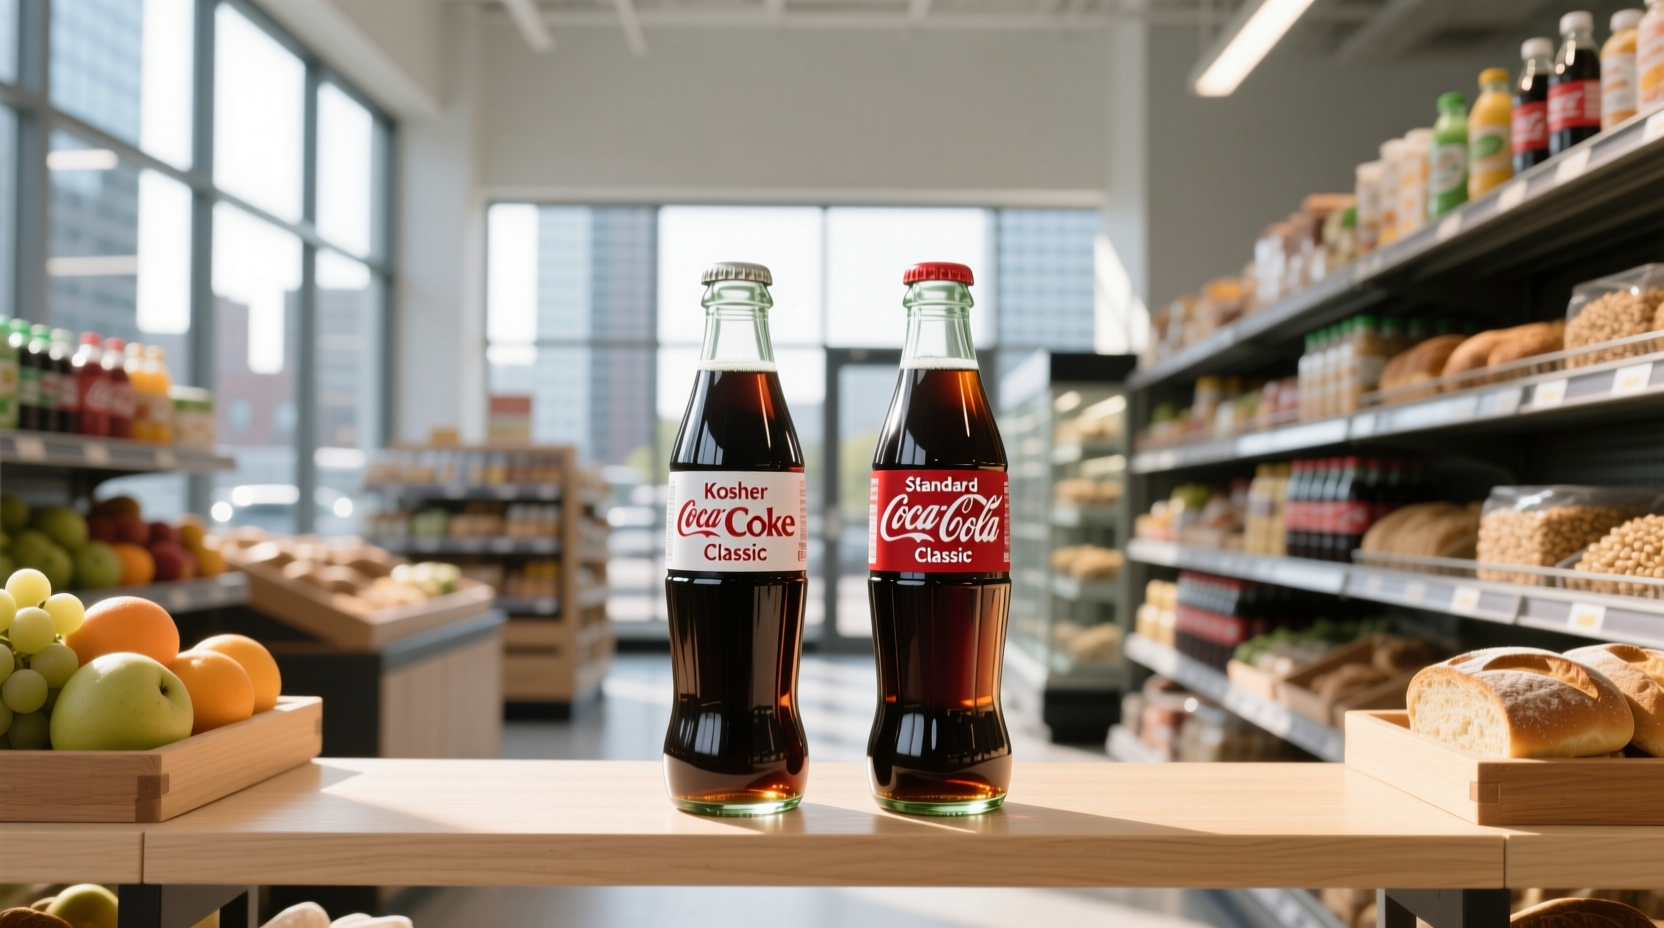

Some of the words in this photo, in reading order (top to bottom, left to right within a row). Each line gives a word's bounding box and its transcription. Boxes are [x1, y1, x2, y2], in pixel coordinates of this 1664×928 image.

[704, 481, 769, 500] Kosher
[905, 476, 978, 492] Standard
[880, 494, 1003, 543] Coca-Cola
[704, 543, 768, 561] Classic
[914, 547, 973, 563] Classic
